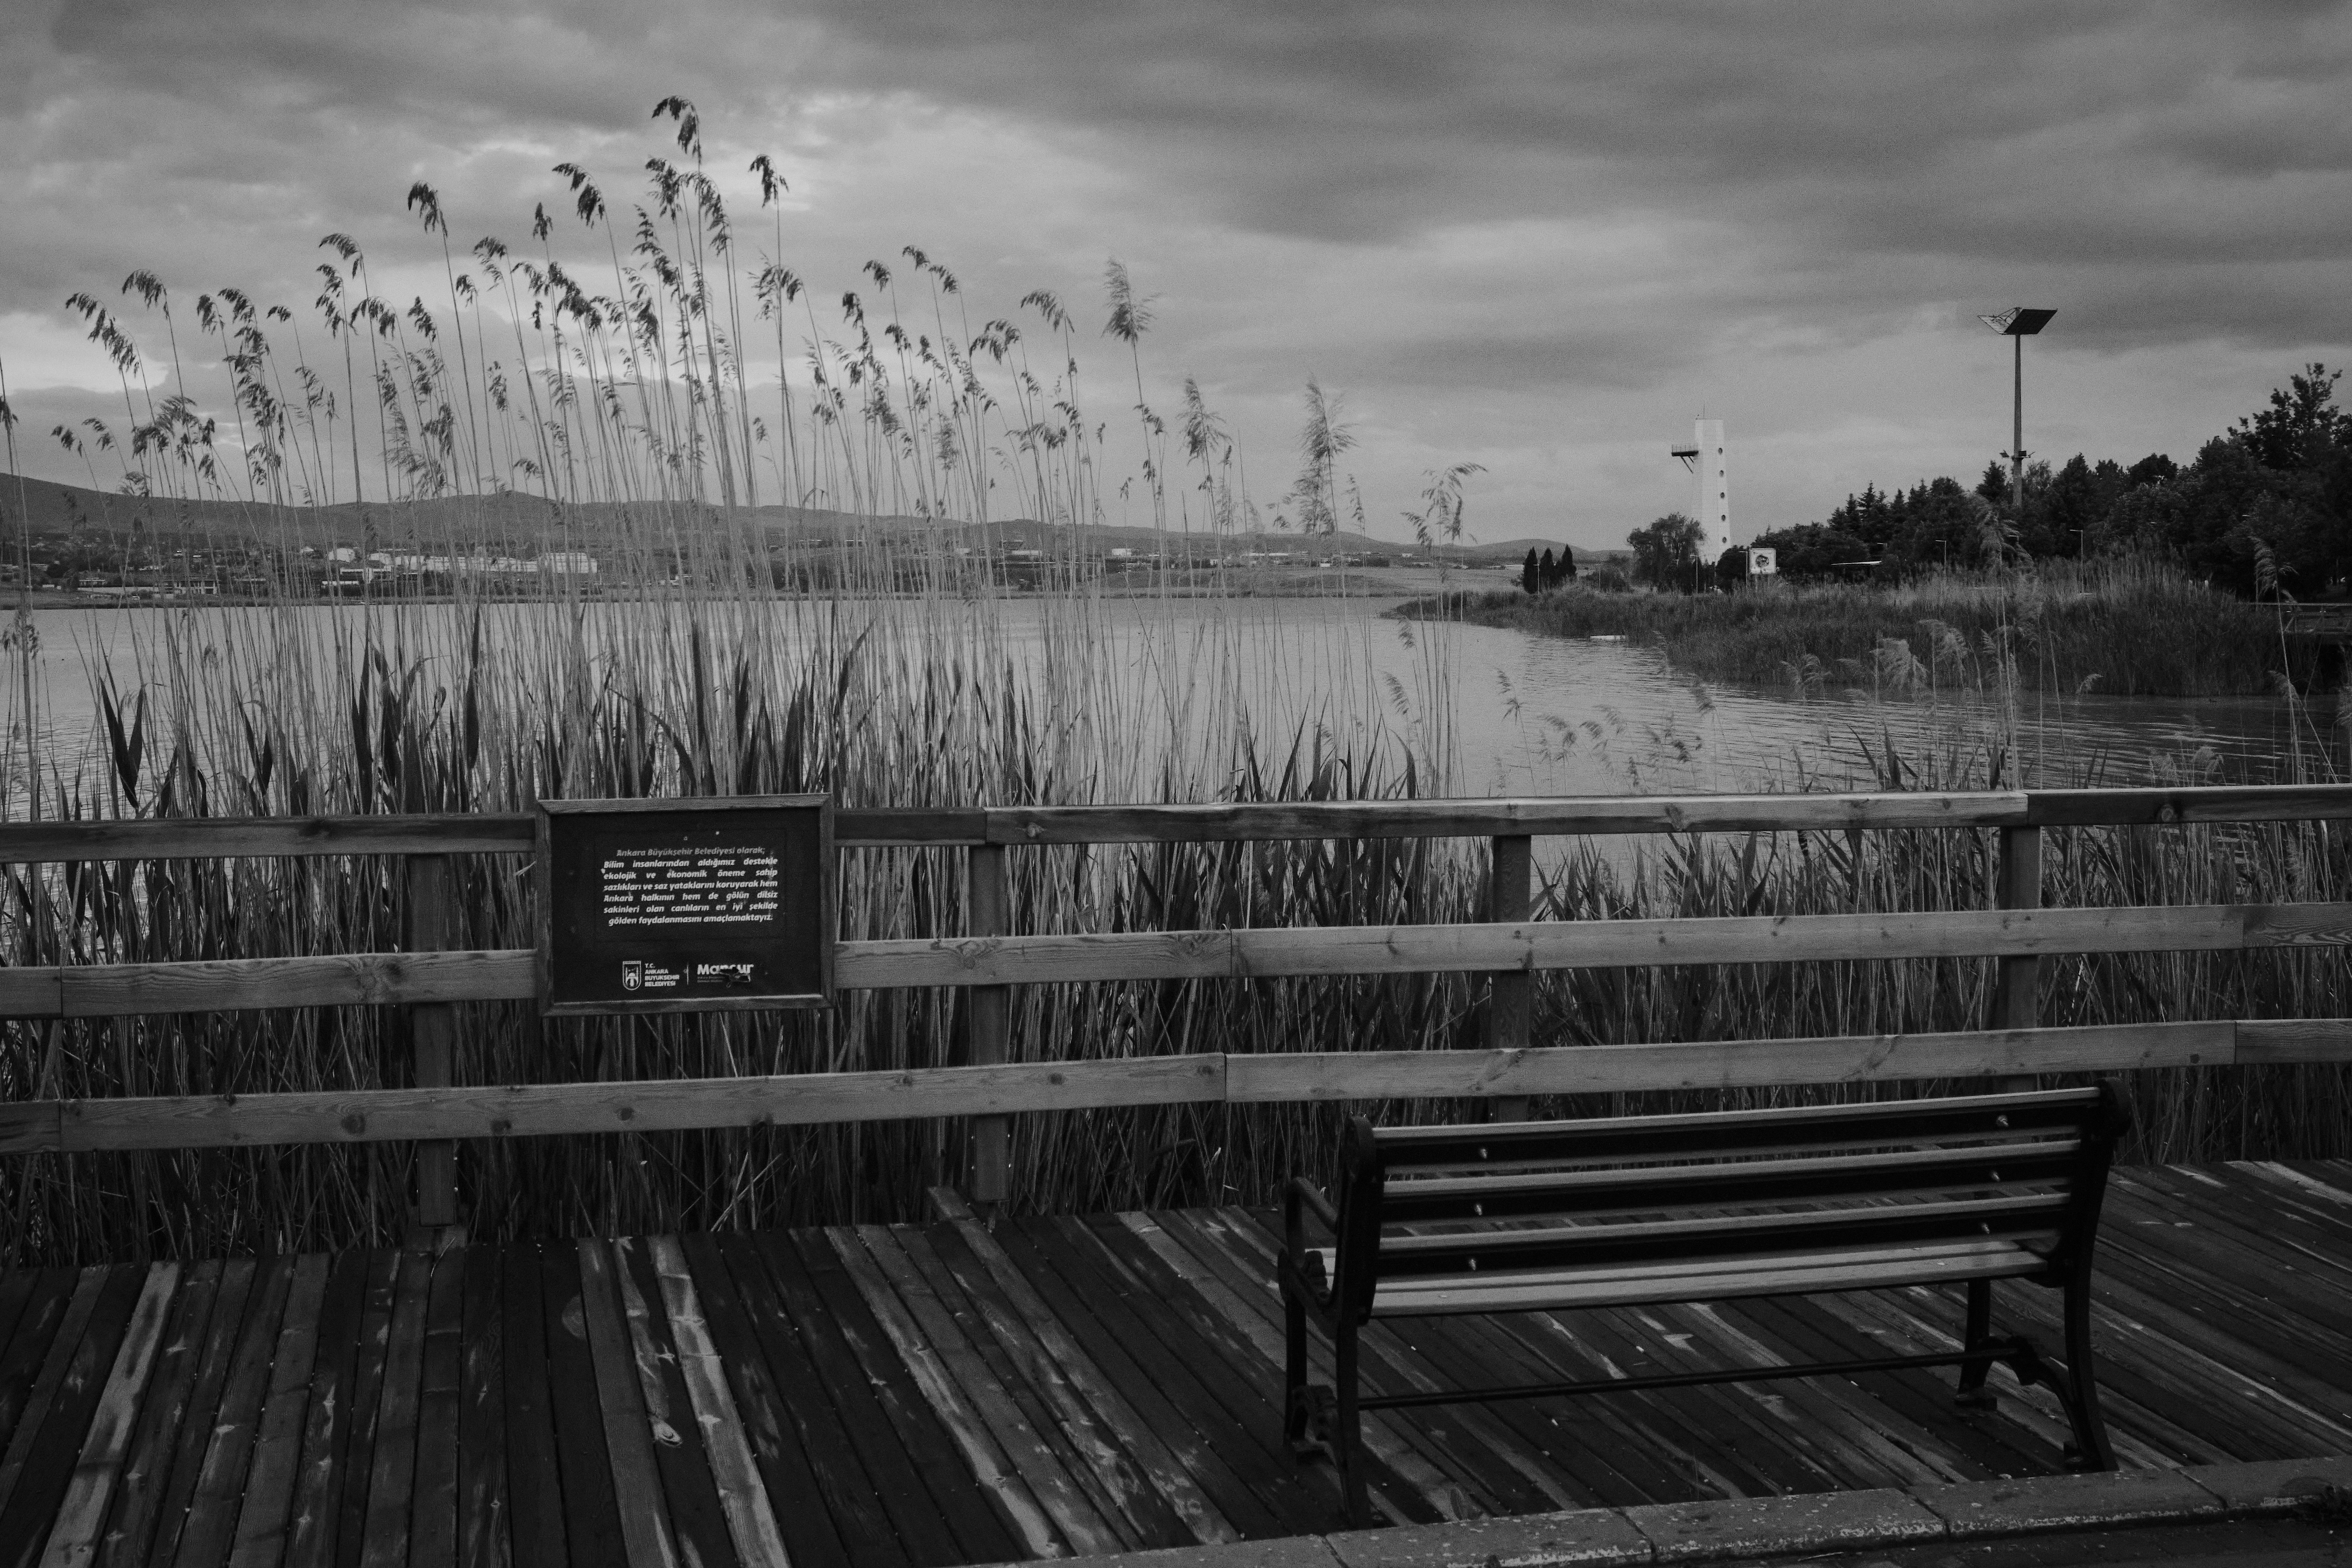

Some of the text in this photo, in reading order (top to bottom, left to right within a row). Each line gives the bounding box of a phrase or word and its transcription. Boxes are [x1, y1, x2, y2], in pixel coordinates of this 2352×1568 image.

[648, 848, 693, 857] Büyükşehir
[694, 847, 735, 856] Belediyesi
[633, 859, 689, 867] insanlarından
[698, 858, 736, 868] aldığımız
[743, 857, 778, 865] destekle
[603, 872, 636, 881] ekolojik
[666, 870, 707, 878] ekonomik
[755, 868, 778, 877] sahip
[670, 881, 715, 891] yataklarını
[716, 880, 758, 890] koruyarak
[726, 891, 750, 901] gölün
[757, 890, 778, 898] dilsiz
[603, 905, 640, 913] sakinleri
[671, 904, 710, 912] canlıların
[732, 903, 743, 912] iyi
[749, 902, 778, 910] şekilde
[608, 913, 773, 927] gölden faydalanmasını amaçlamaktayız.
